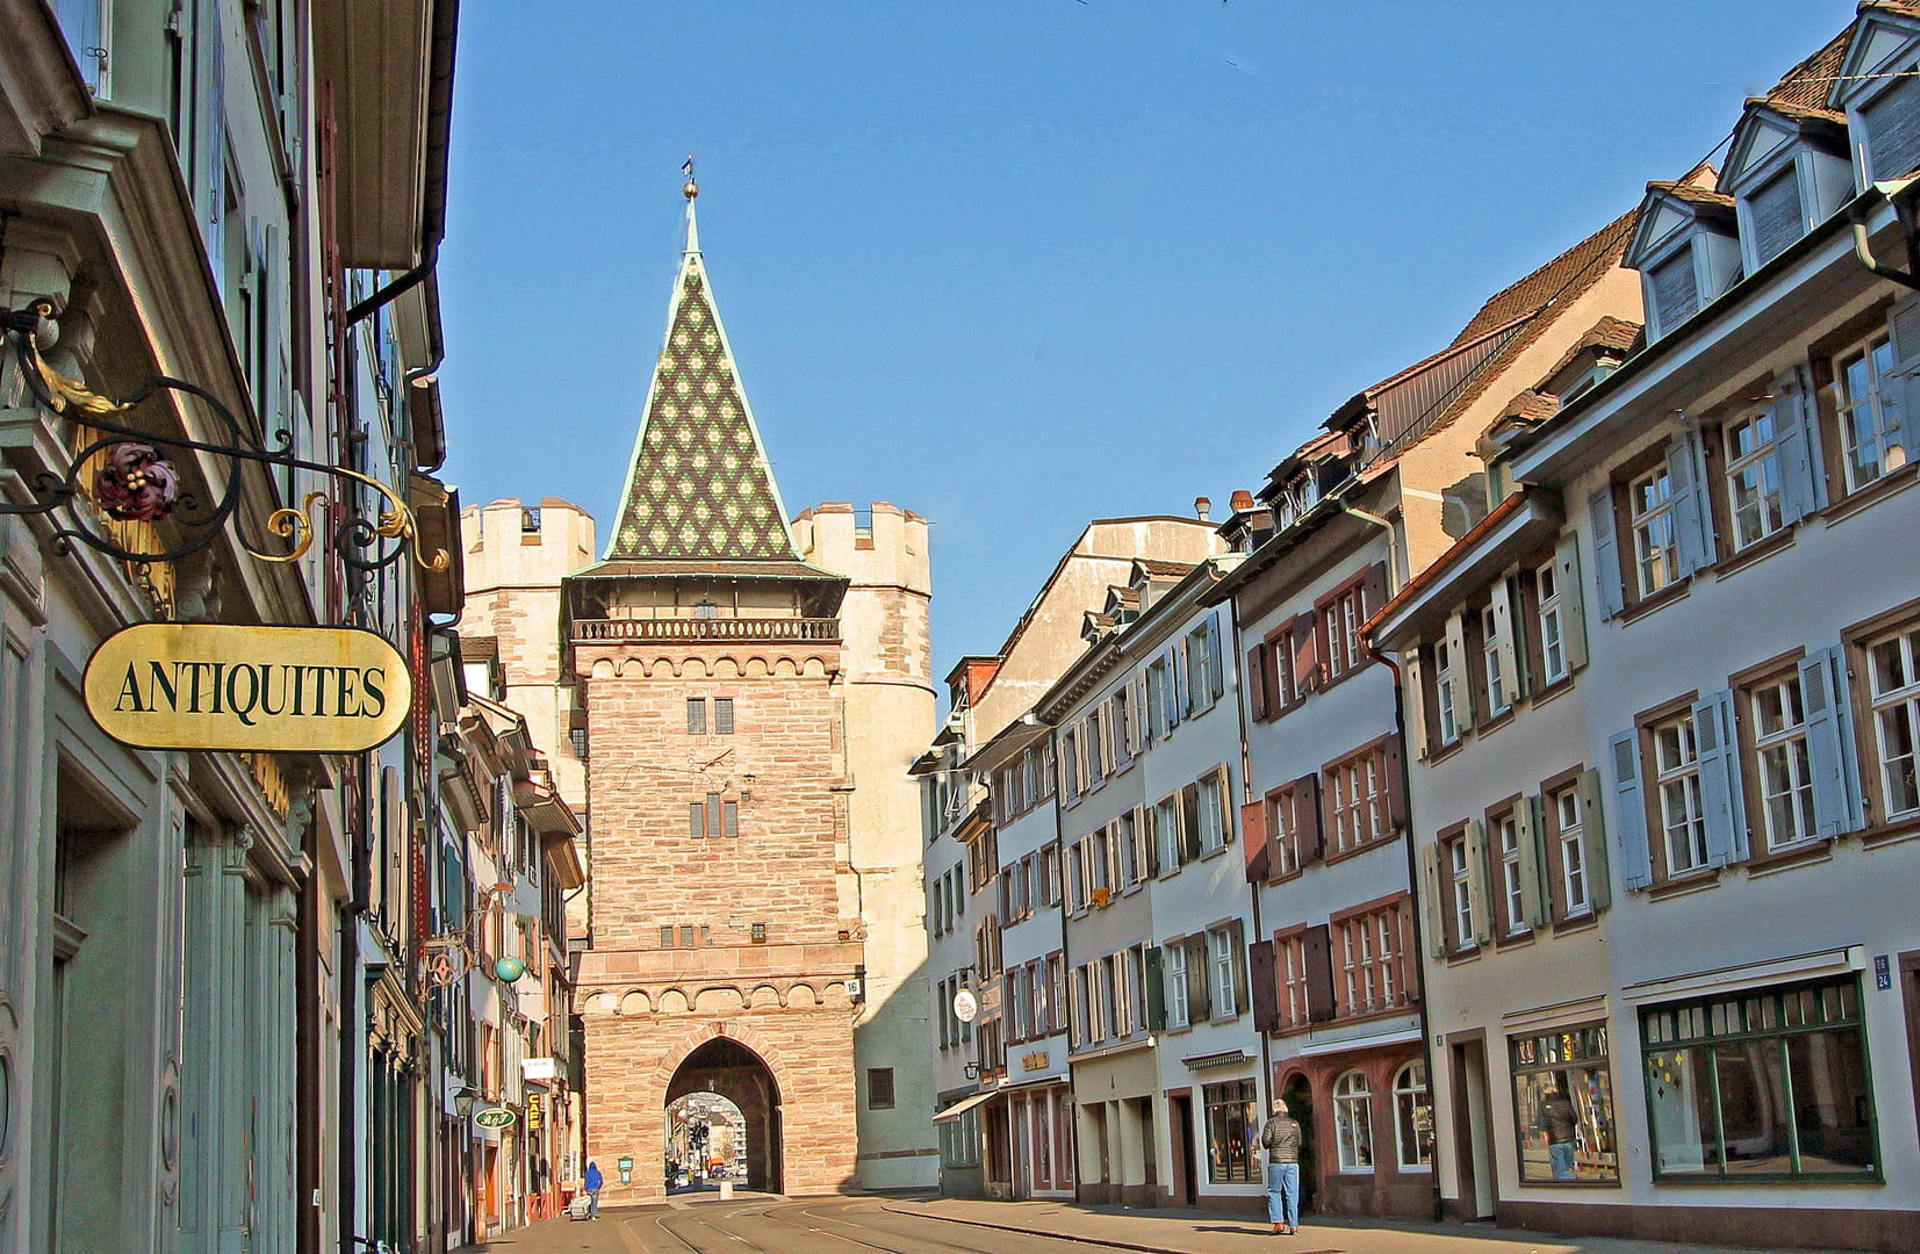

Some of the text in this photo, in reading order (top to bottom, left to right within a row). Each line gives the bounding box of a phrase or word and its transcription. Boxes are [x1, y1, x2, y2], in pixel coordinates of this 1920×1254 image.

[114, 661, 386, 726] ANTIQUITES
[1879, 976, 1888, 987] 24
[848, 982, 858, 993] 16
